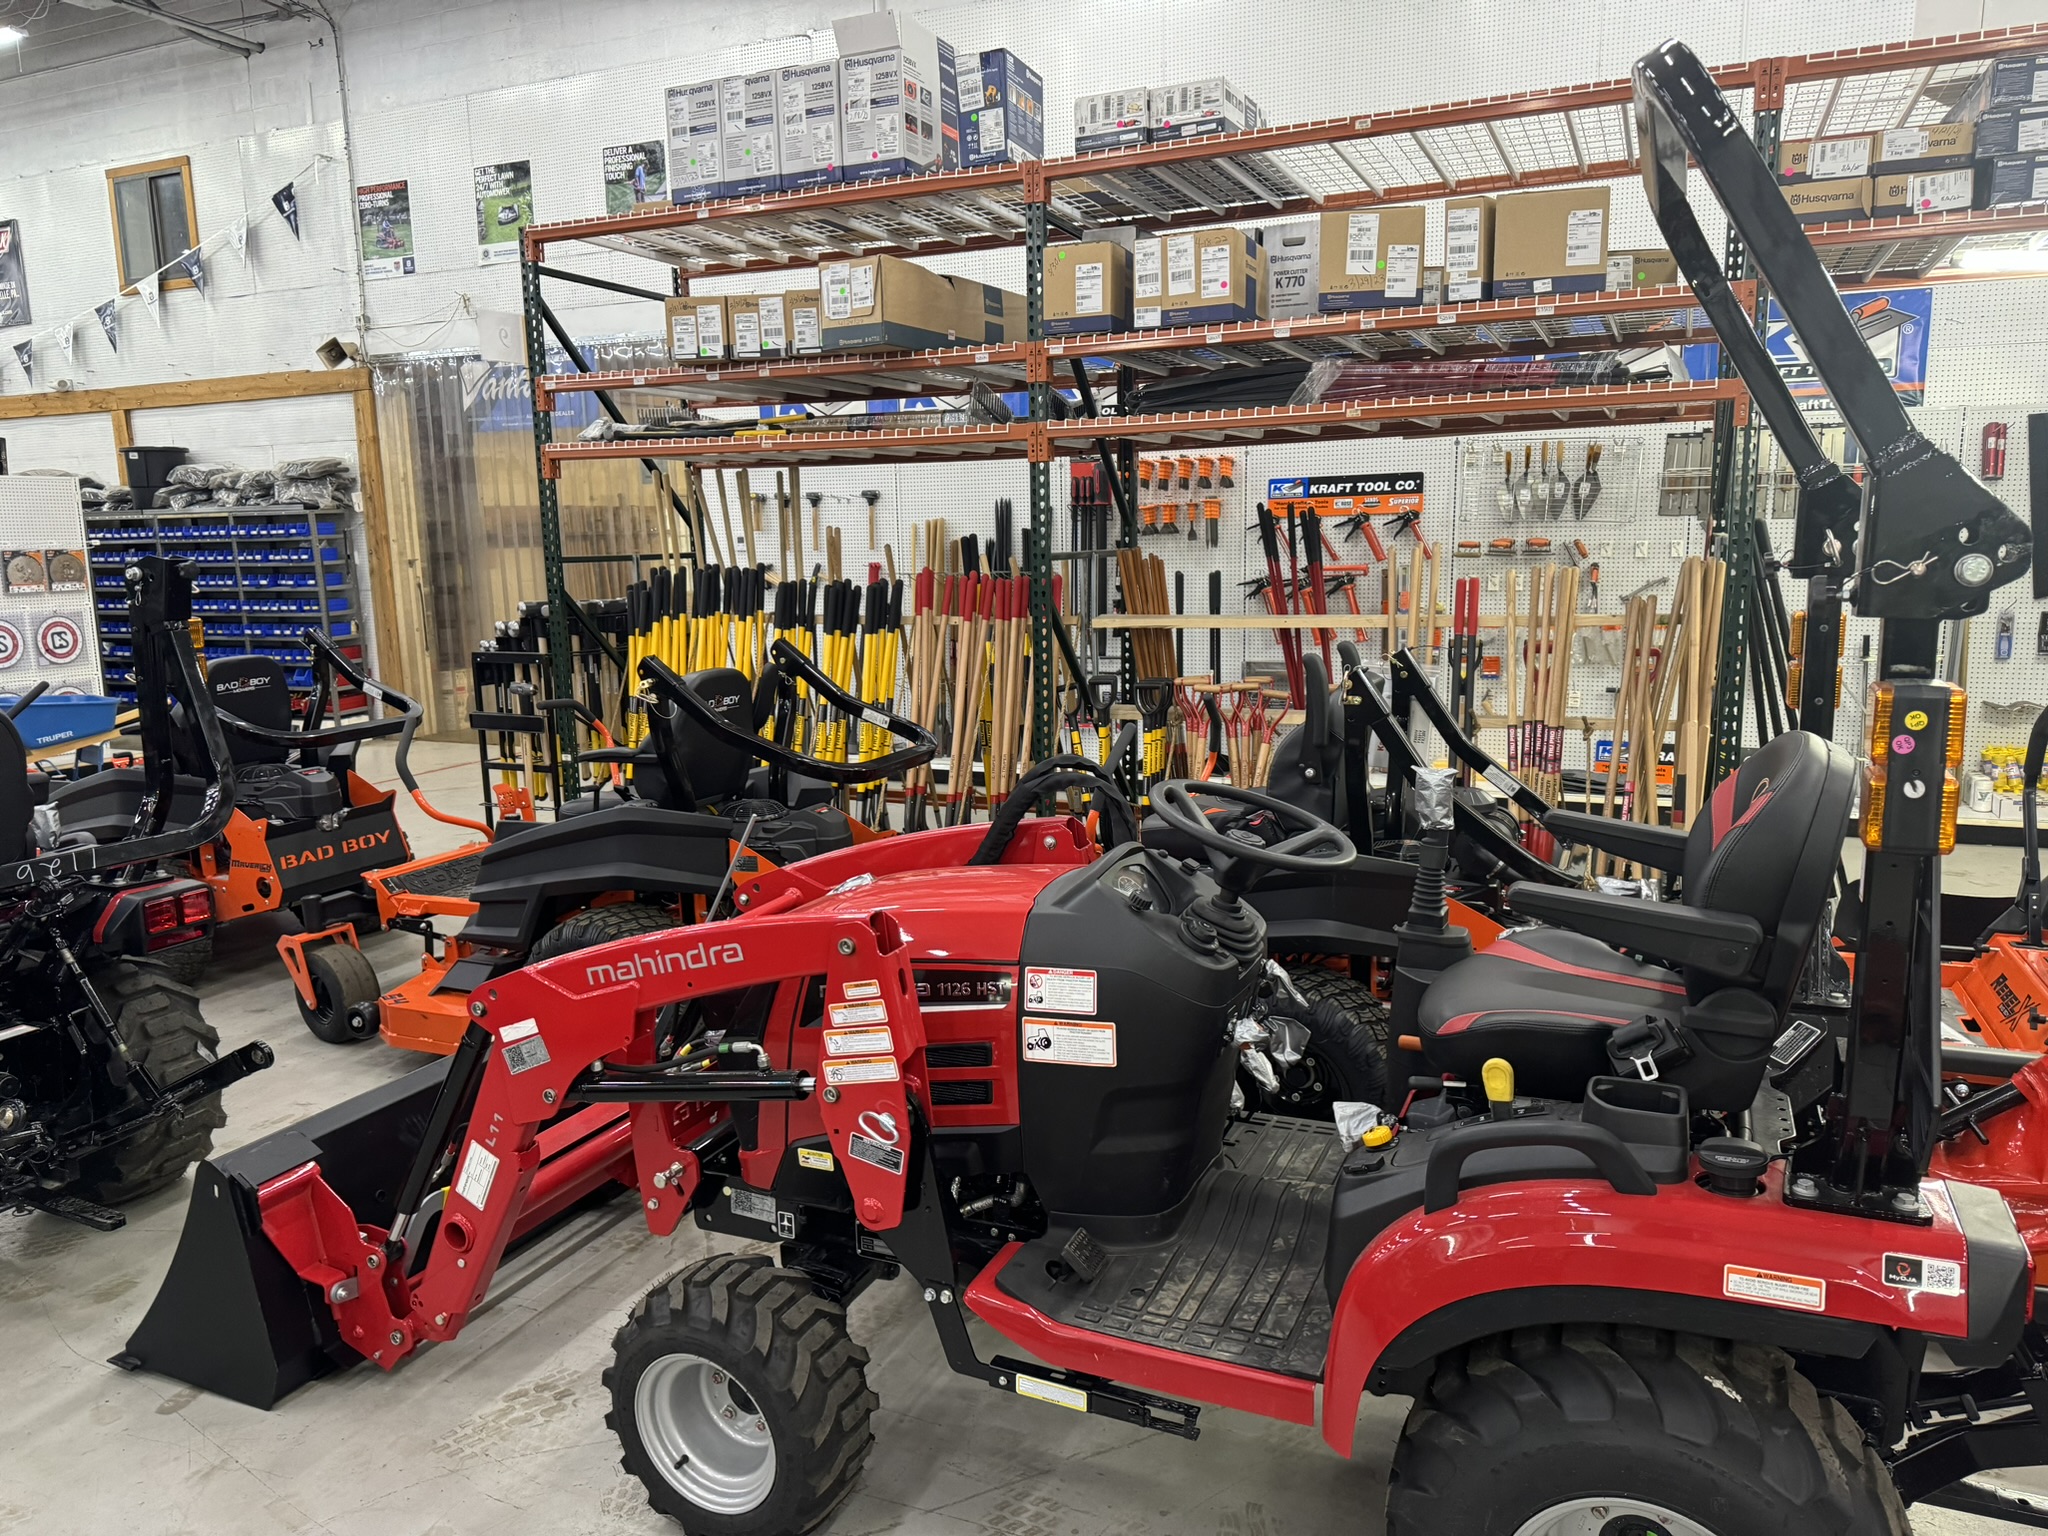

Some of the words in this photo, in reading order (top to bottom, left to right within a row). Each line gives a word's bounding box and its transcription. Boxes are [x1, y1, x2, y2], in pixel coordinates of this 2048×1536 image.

[853, 54, 895, 68] Husqvarna
[790, 64, 831, 79] Husqvarna
[603, 147, 627, 157] DELIVER
[604, 152, 646, 164] PROFESSIONAL
[475, 168, 484, 176] GET
[484, 167, 495, 175] THE
[605, 163, 633, 172] FINISHING
[475, 174, 497, 184] PERFECT
[497, 171, 514, 180] LAWN
[605, 172, 625, 181] TOUCH
[358, 186, 369, 195] HIGH
[370, 182, 406, 193] PERFORMANCE
[476, 184, 488, 192] 24/7
[489, 182, 504, 190] WITH
[358, 192, 394, 202] PROFESSIONAL
[476, 188, 510, 199] AUTOMOWER
[1801, 192, 1855, 203] Husqvarna
[359, 200, 390, 209] ZERO-TURNS
[1277, 253, 1312, 263] Husqvarna
[1290, 268, 1308, 276] CUTTER
[1275, 277, 1285, 289] K
[1285, 275, 1305, 288] 770
[1309, 483, 1353, 495] KRAFT
[1356, 482, 1391, 493] TOOL
[1395, 480, 1417, 490] CO.
[1388, 497, 1420, 506] SUPERIOR
[216, 681, 239, 692] BAD
[249, 676, 271, 686] BOY
[723, 694, 741, 705] BOY
[36, 730, 74, 744] TRUPER
[279, 845, 334, 870] BAD
[342, 829, 391, 854] BOY
[231, 859, 272, 870] MAVERICK
[585, 942, 745, 986] mahindra
[937, 981, 971, 996] 1126
[976, 981, 1006, 996] HST
[1990, 972, 2021, 1016] REBEL
[1763, 1272, 1793, 1283] WARNING
